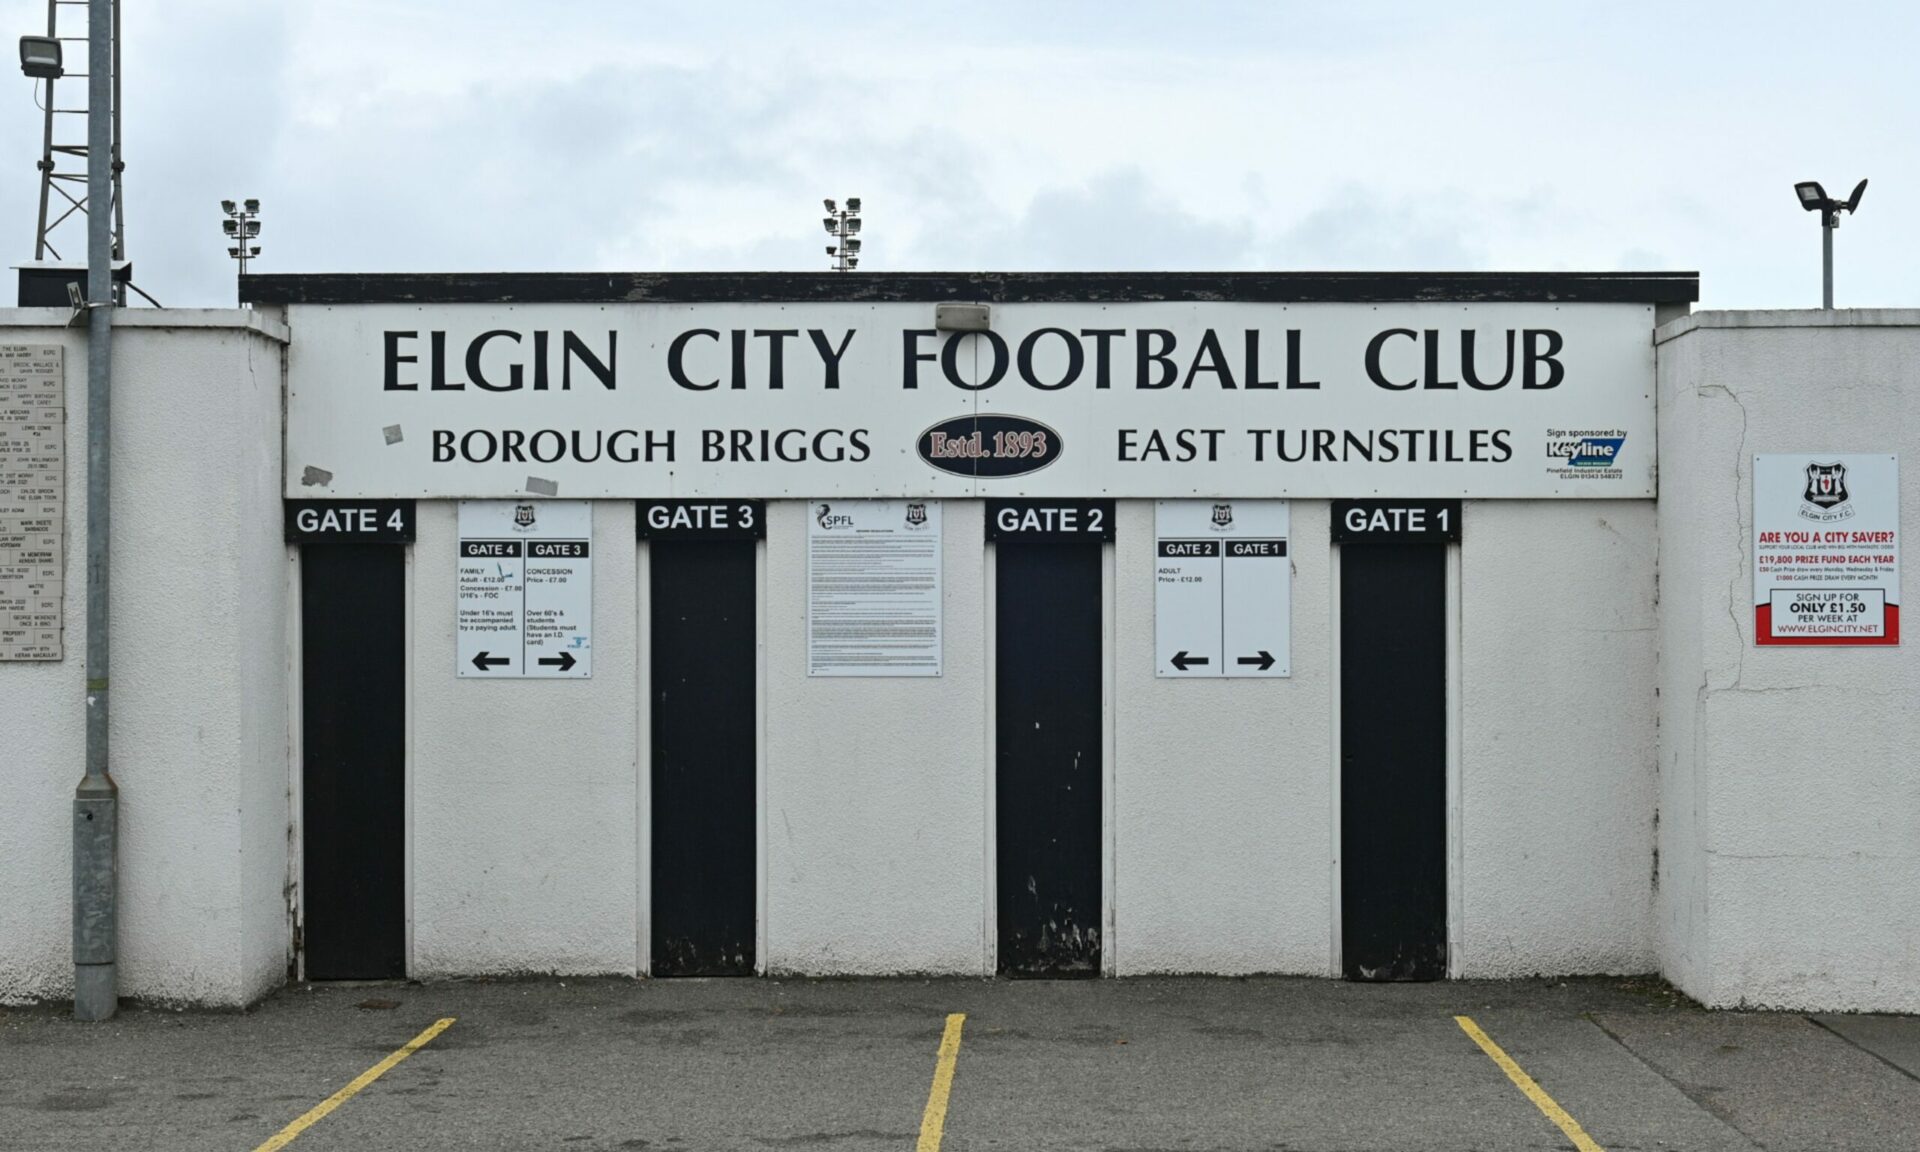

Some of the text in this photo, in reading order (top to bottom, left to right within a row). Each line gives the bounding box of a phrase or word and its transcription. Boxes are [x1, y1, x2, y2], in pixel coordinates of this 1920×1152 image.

[383, 327, 1565, 392] ELGIN CITY FOOTBALL CLUB
[1546, 429, 1628, 438] Sign sponsored by
[432, 429, 871, 463] BOROUGH BRIGGS
[930, 431, 1047, 458] Estd. 1893
[1116, 428, 1513, 463] EAST TURNSTILES
[1547, 442, 1614, 460] Keyline
[296, 509, 403, 532] GATE 4
[647, 506, 754, 529] GATE 3
[826, 515, 854, 525] SPFL
[996, 508, 1104, 532] GATE 2
[1345, 508, 1450, 532] GATE 1
[1801, 509, 1820, 520] ELGIN
[1759, 531, 1895, 543] ARE YOU A CITY SAVER?
[468, 544, 514, 556] GATE 4
[535, 544, 581, 556] GATE 3
[1166, 544, 1212, 555] GATE 2
[1233, 544, 1279, 555] GATE 1
[1759, 555, 1895, 565] £19,800 PRIZE FUND EACH YEAR
[1796, 593, 1859, 602] SIGN UP FOR
[1790, 602, 1866, 613] ONLY £1.50
[470, 617, 514, 625] accompanied
[1798, 614, 1858, 623] PER WEEK AT
[1777, 624, 1878, 633] WWW.ELGINCITY.NET
